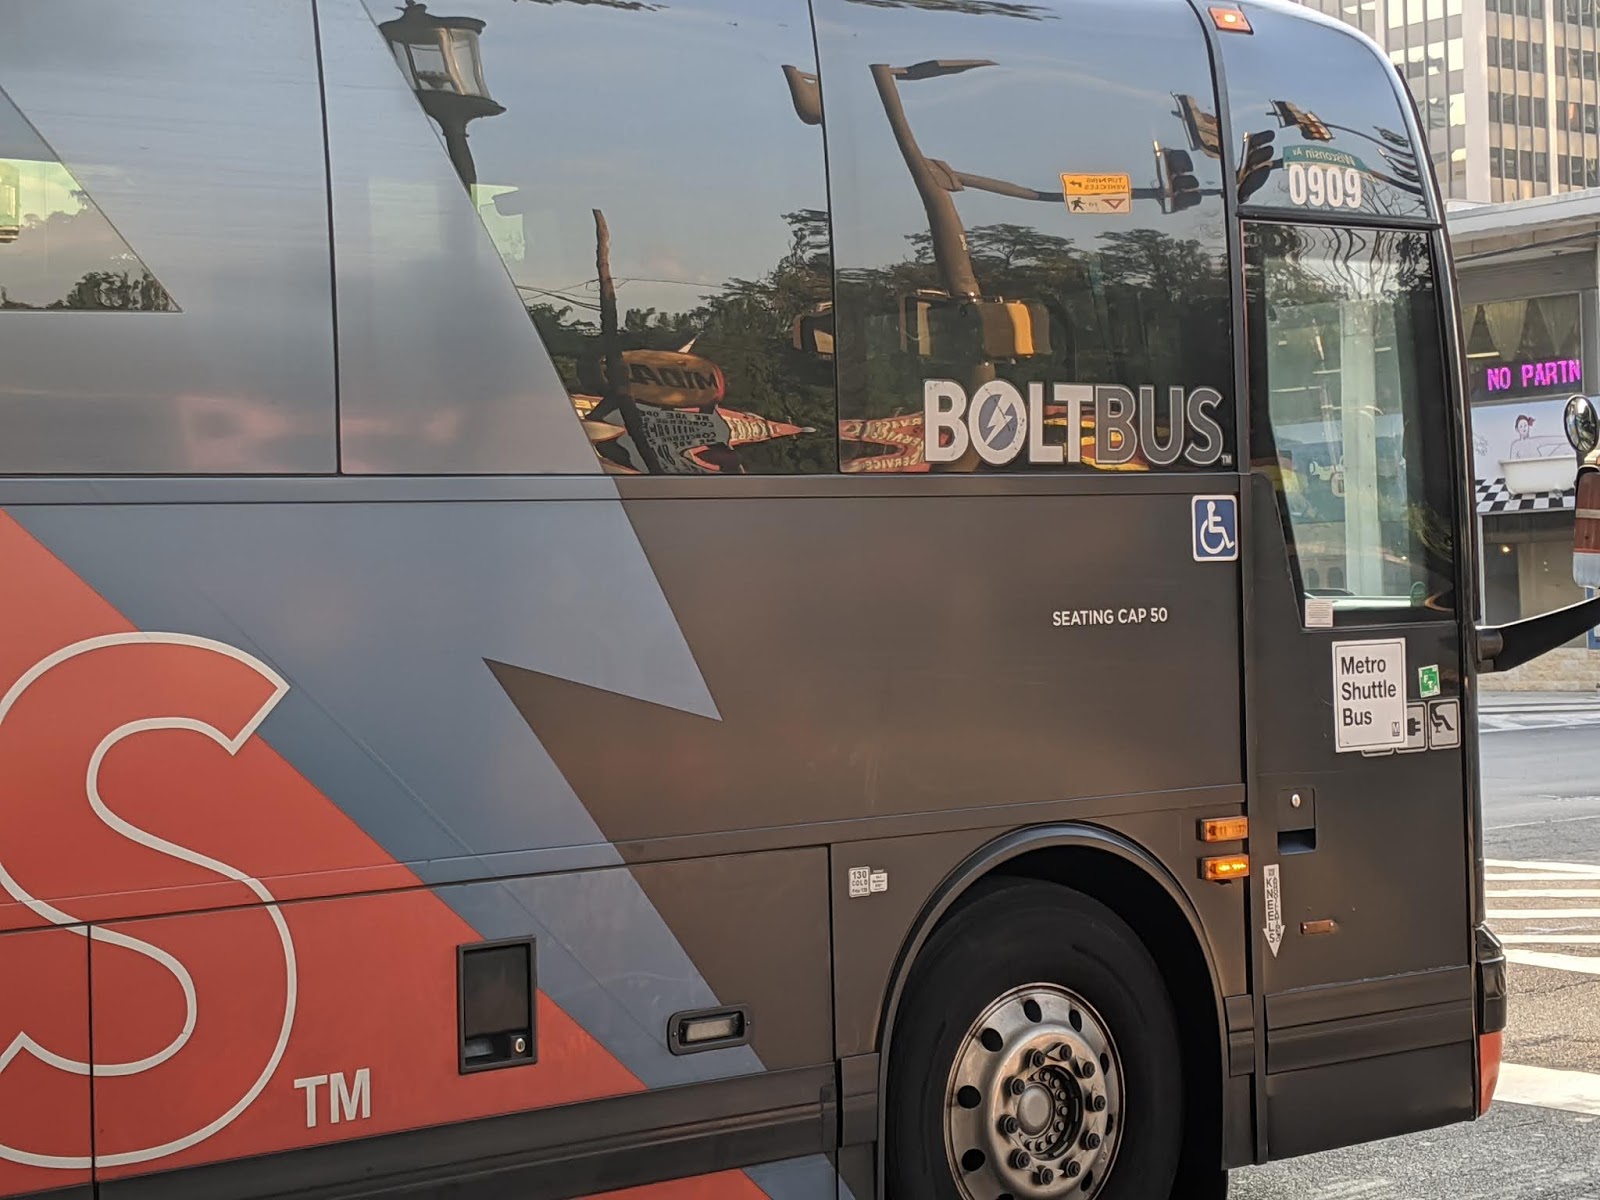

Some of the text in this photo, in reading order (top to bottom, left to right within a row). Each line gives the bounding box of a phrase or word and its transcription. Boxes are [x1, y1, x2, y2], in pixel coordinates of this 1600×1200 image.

[1289, 164, 1362, 208] 0909
[1487, 360, 1581, 392] NO PARTN
[923, 379, 1225, 466] BOLTBUS
[1052, 607, 1168, 626] SEATING CAP 50
[1341, 656, 1386, 675] Metro
[1341, 680, 1396, 701] Shuttle
[1343, 707, 1372, 726] Bus
[852, 871, 867, 879] 130
[1266, 878, 1276, 943] KNEELS
[294, 1068, 371, 1127] TM
